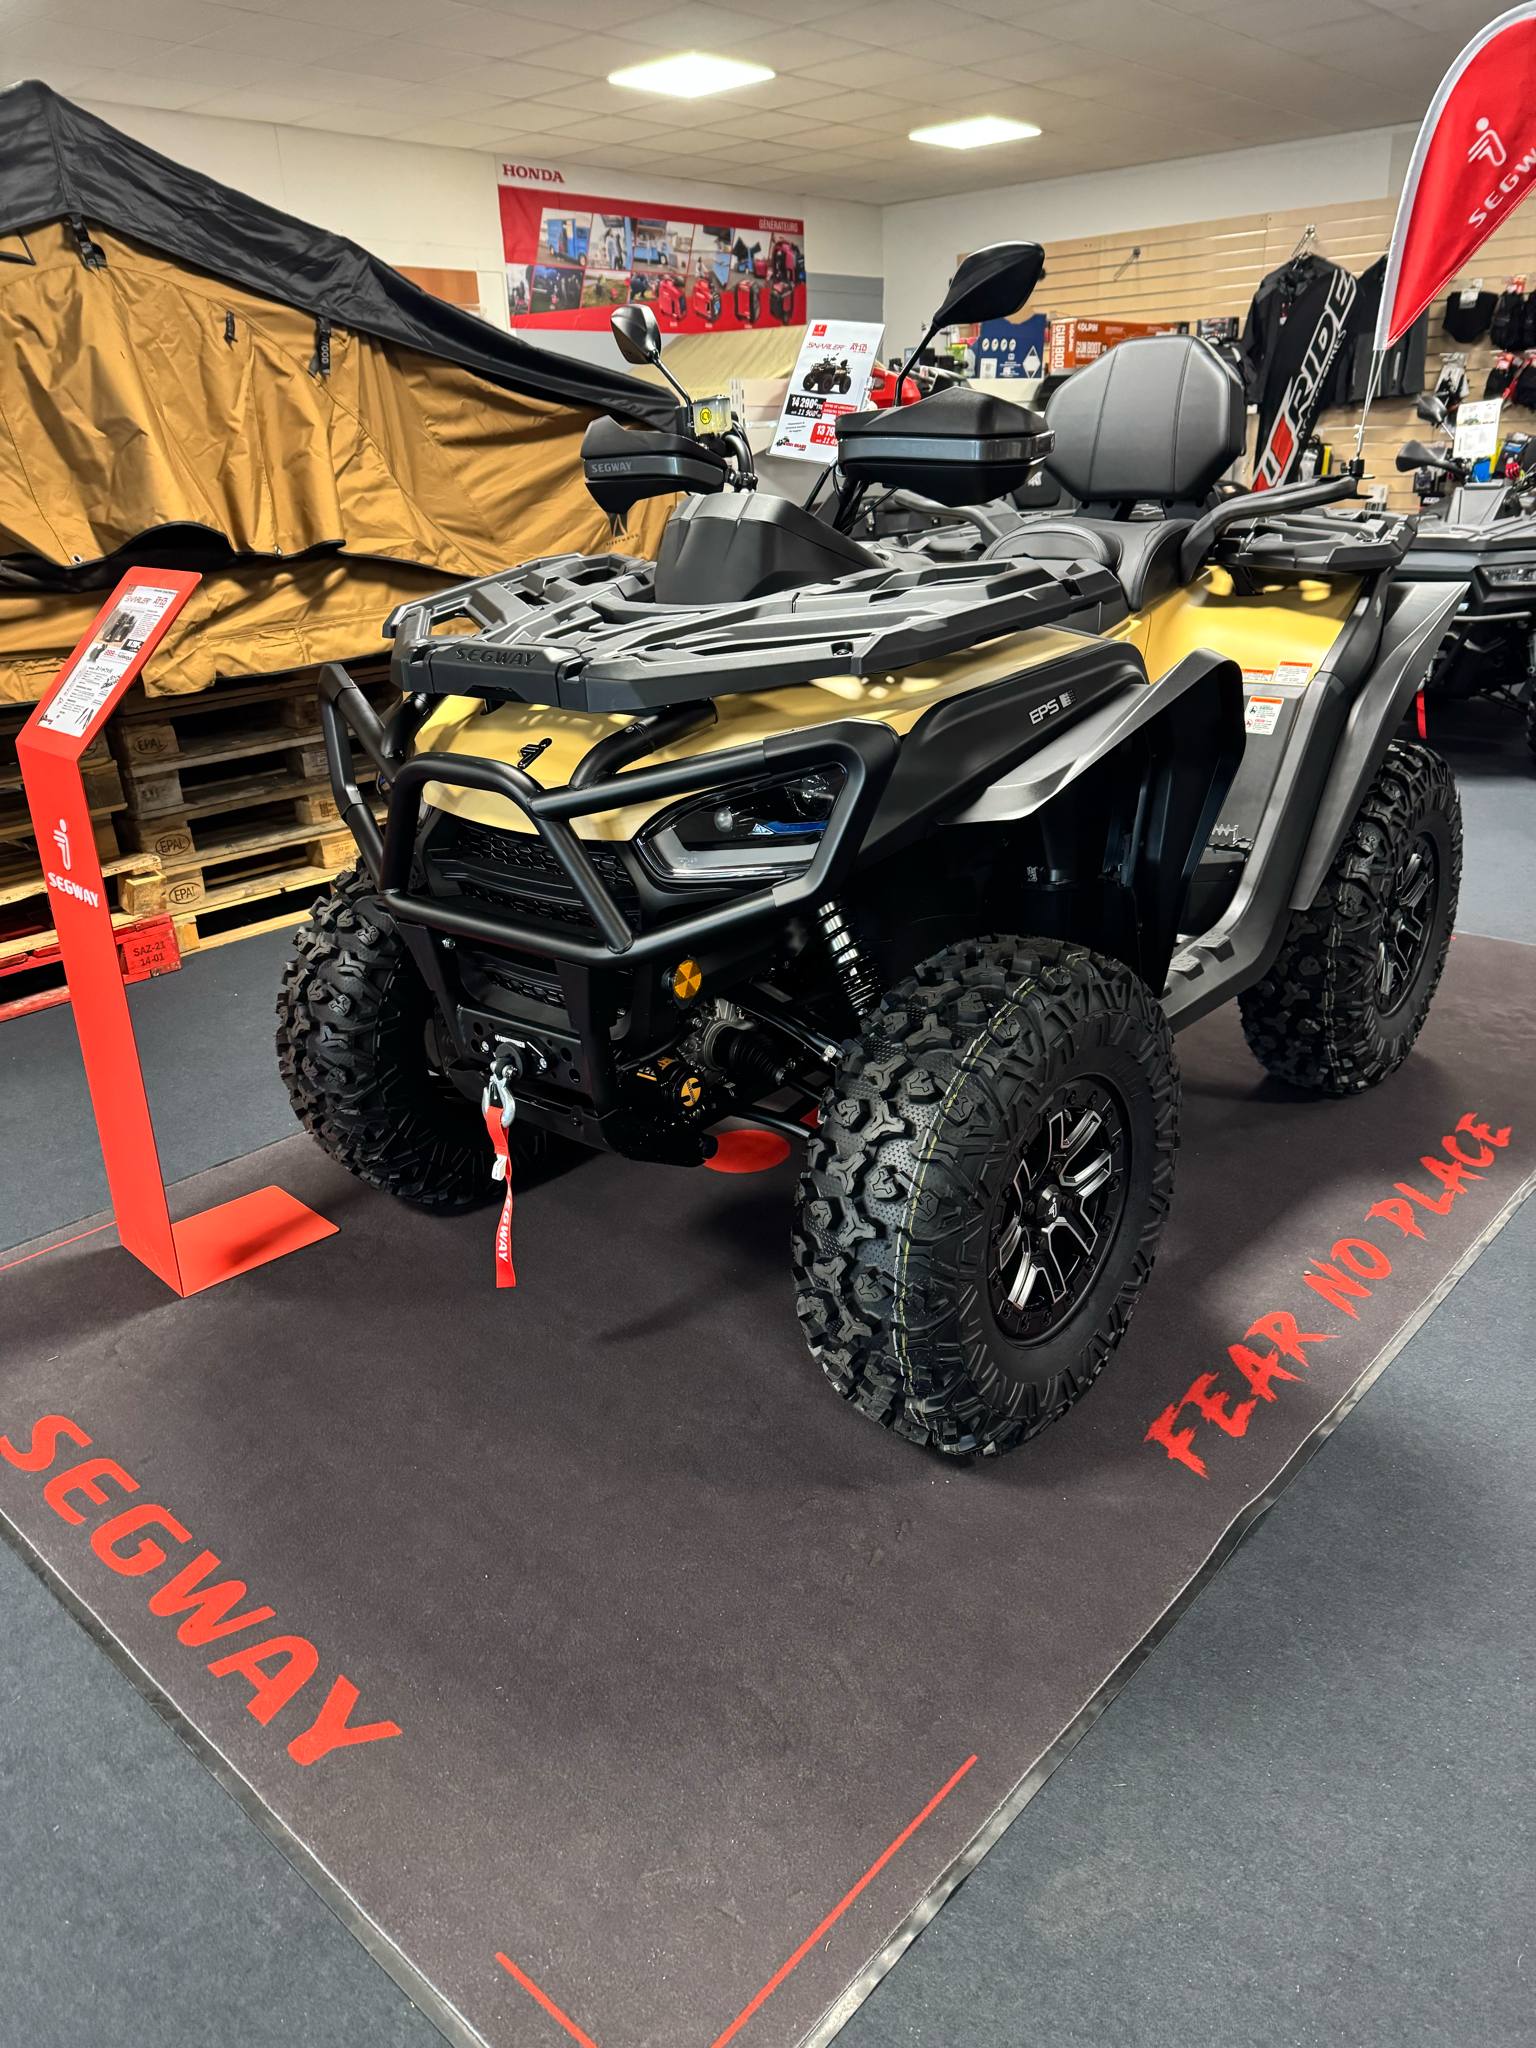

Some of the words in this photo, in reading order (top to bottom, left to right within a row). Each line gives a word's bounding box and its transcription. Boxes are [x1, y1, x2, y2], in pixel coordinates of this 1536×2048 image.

[502, 162, 565, 183] HONDA
[591, 461, 632, 474] SEGWAY
[456, 647, 537, 668] SEGWAY
[1029, 698, 1060, 725] EPS
[136, 738, 164, 750] EPAL
[159, 838, 186, 853] EPAL
[48, 871, 99, 908] SEGWAY
[133, 940, 167, 957] SAZ-21
[1143, 1311, 1341, 1480] FEAR
[1303, 1238, 1393, 1321] NO
[1364, 1112, 1513, 1241] PLACE
[0, 1415, 402, 1766] SEGWAY
